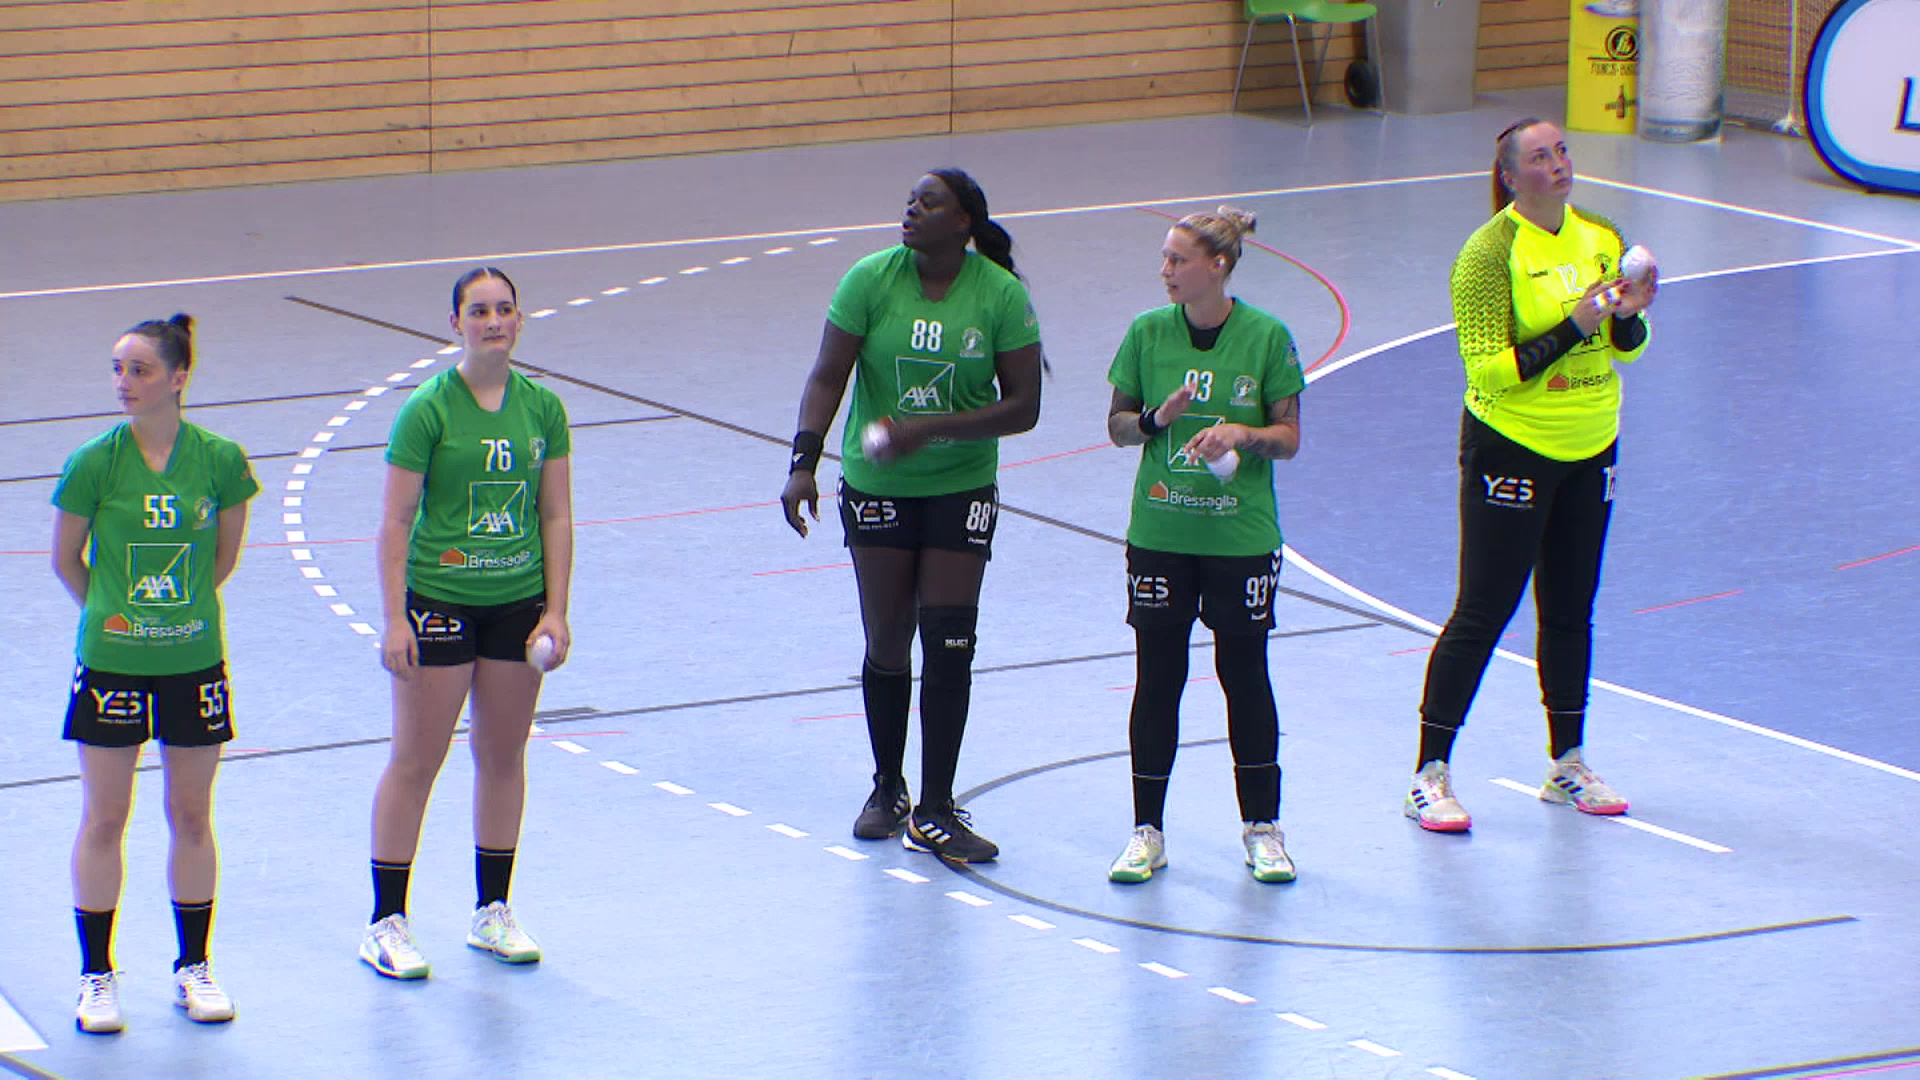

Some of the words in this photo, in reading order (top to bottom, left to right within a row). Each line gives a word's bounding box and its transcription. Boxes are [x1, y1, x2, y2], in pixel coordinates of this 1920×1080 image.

[1557, 264, 1585, 293] 12
[911, 319, 943, 352] 88
[900, 386, 942, 408] AXA
[481, 439, 513, 472] 76
[1170, 490, 1238, 510] Bressaglia
[1482, 474, 1534, 501] YES
[144, 494, 179, 528] 55
[471, 511, 515, 532] AXA
[849, 500, 897, 522] YES
[966, 500, 991, 532] 88
[132, 575, 179, 598] AXA
[1130, 575, 1169, 600] YES
[1246, 575, 1268, 608] 93
[409, 609, 463, 633] YES
[945, 638, 969, 648] SELECT
[90, 688, 143, 715] YES
[199, 680, 225, 718] 55
